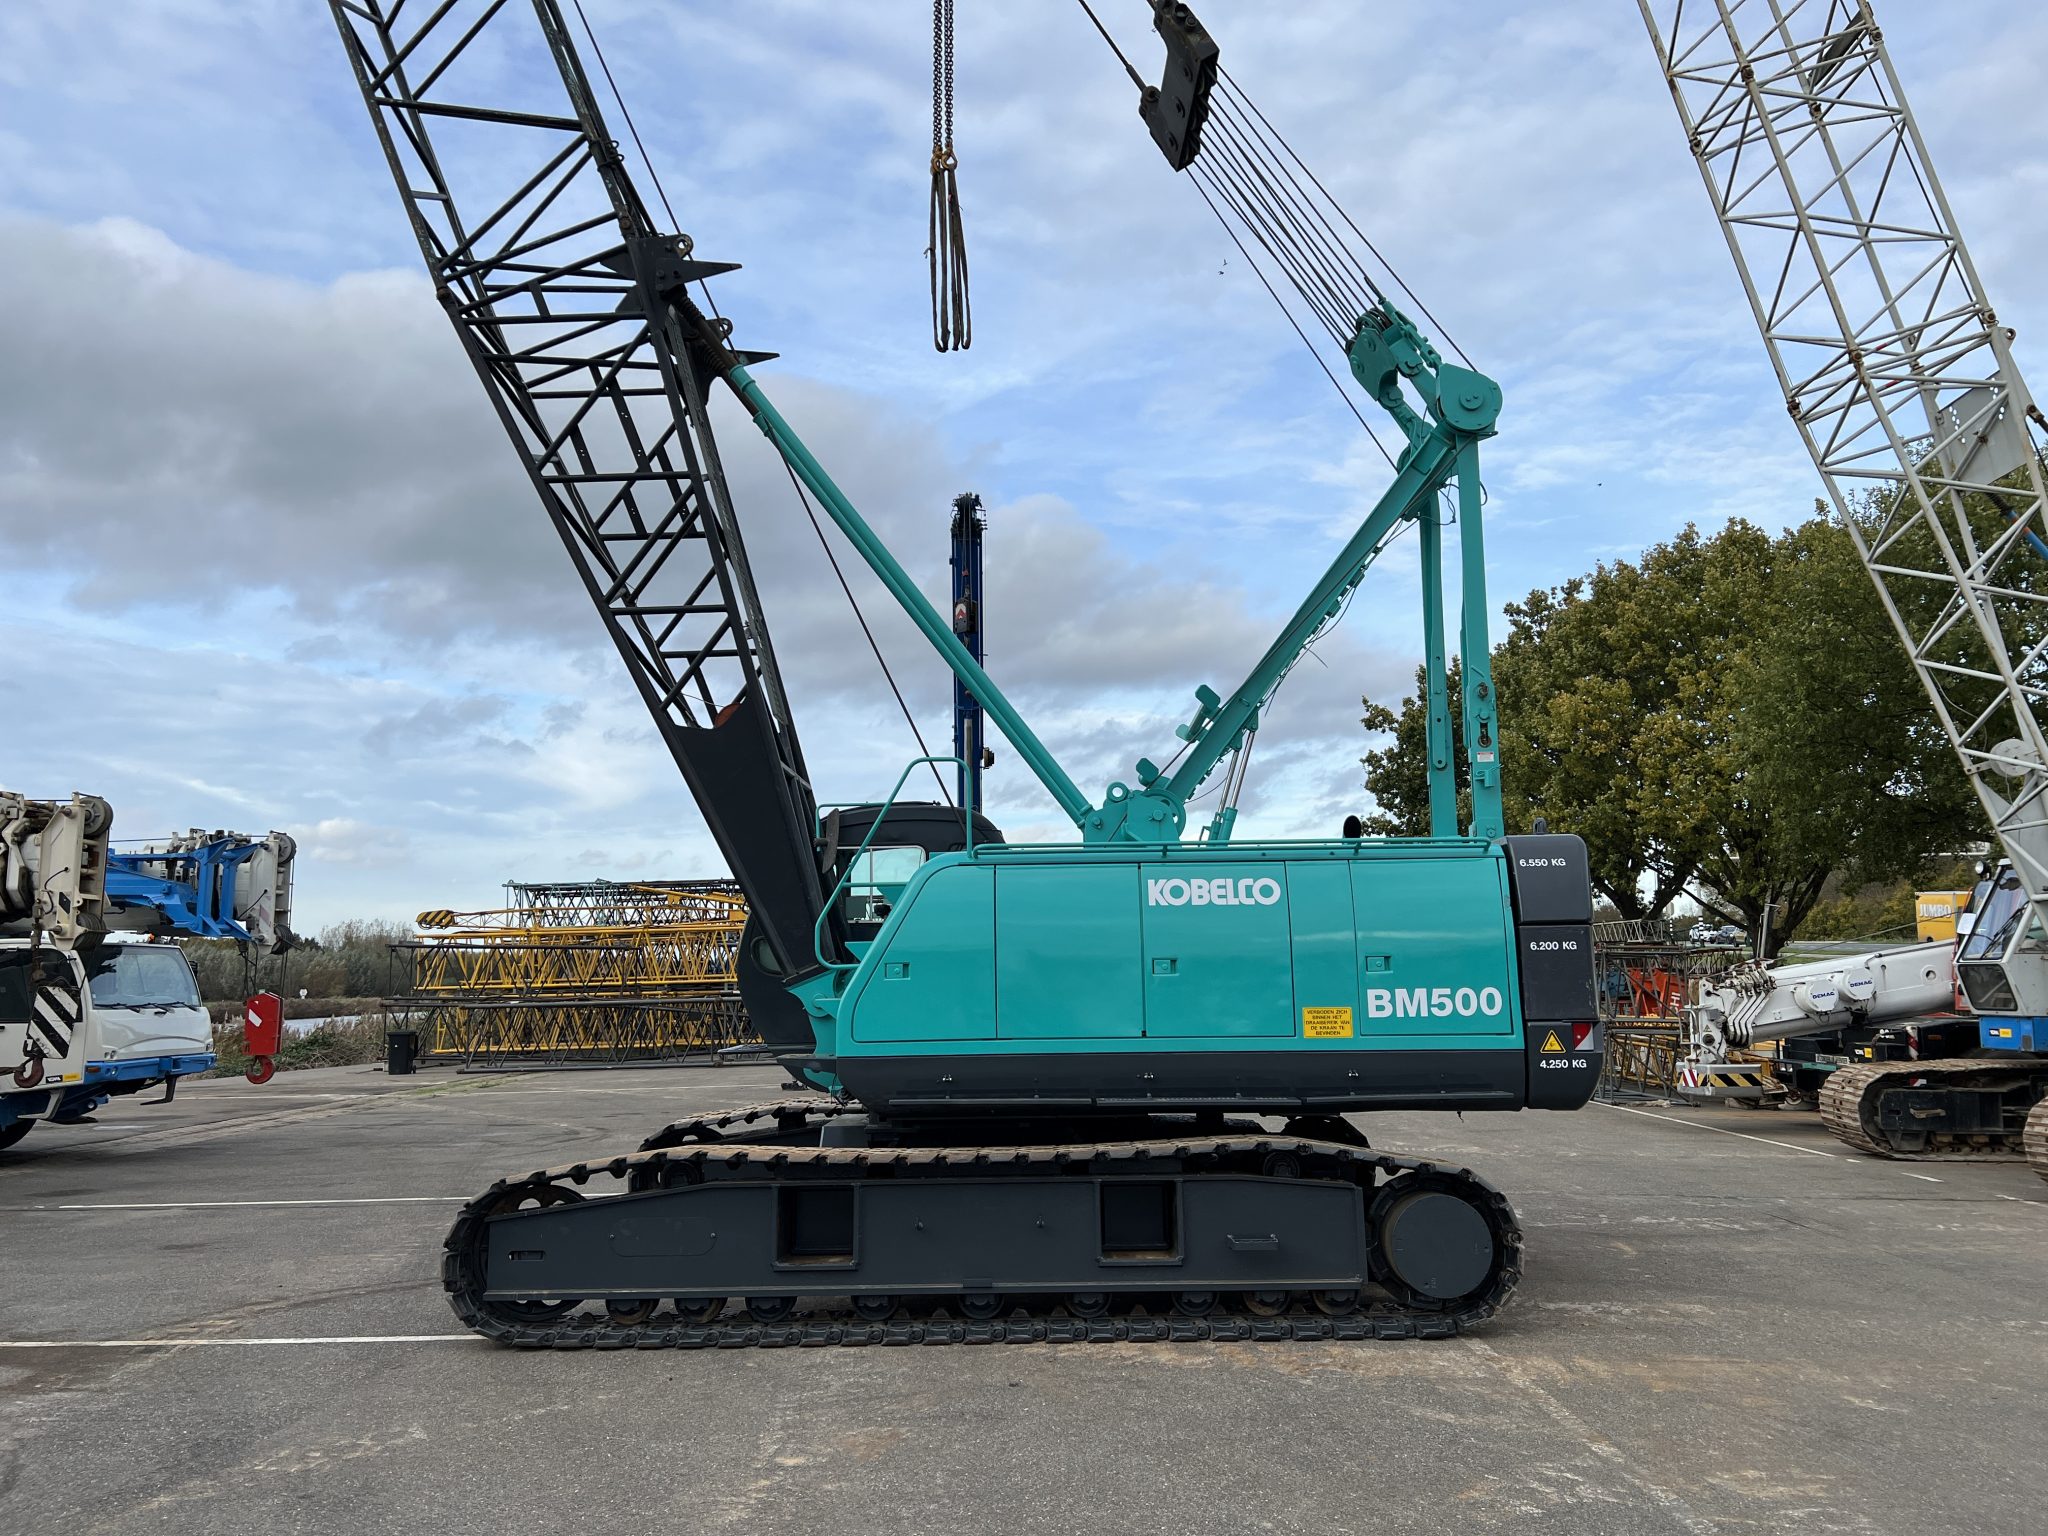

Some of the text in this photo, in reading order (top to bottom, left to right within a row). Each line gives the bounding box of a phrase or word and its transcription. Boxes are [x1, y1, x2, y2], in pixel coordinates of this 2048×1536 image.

[1519, 858, 1566, 867] 6.550 KG
[1147, 877, 1281, 906] KOBELCO
[1920, 903, 1952, 918] JUMBO
[1530, 941, 1577, 950] 6.200 KG
[1850, 980, 1873, 988] DEMAG
[1812, 991, 1835, 999] DEMAG
[1366, 986, 1503, 1018] BM500
[1540, 1059, 1587, 1069] 4.250 KG
